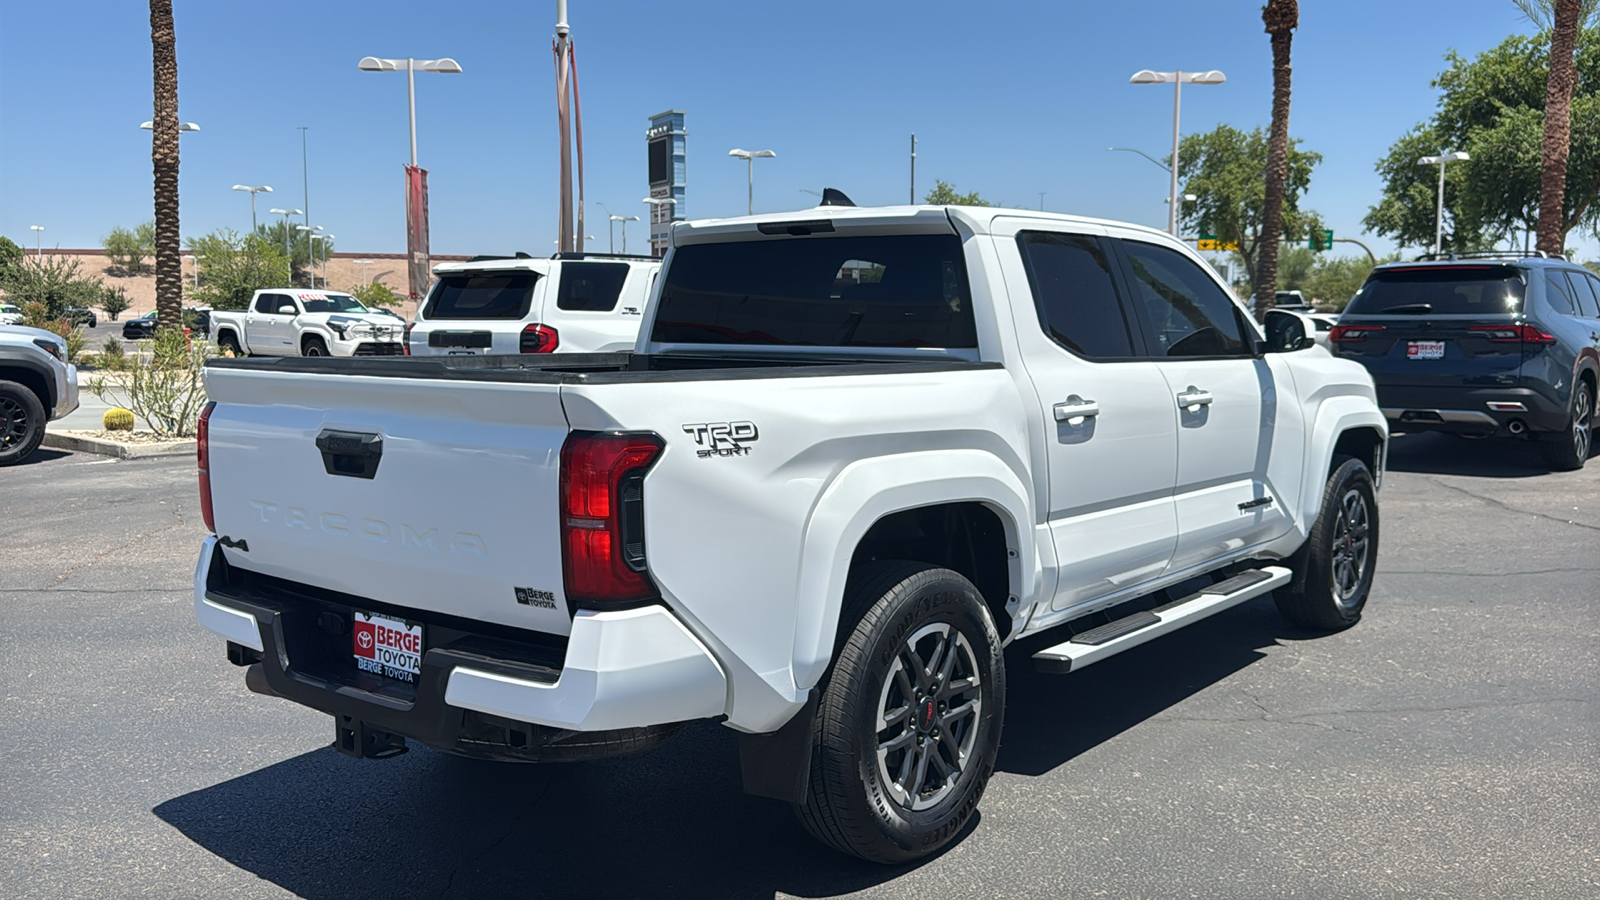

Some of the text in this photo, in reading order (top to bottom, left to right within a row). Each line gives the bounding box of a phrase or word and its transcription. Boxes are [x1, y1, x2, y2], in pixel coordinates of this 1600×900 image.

[682, 421, 759, 448] TRD
[696, 447, 752, 458] SPORT
[250, 499, 489, 560] TACOMA
[526, 587, 554, 602] BERGE
[529, 600, 557, 610] TOYOTA
[377, 625, 420, 653] BERGE
[357, 658, 382, 674] BERGE
[376, 648, 420, 671] TOYOTA
[384, 667, 413, 683] TOYOTA
